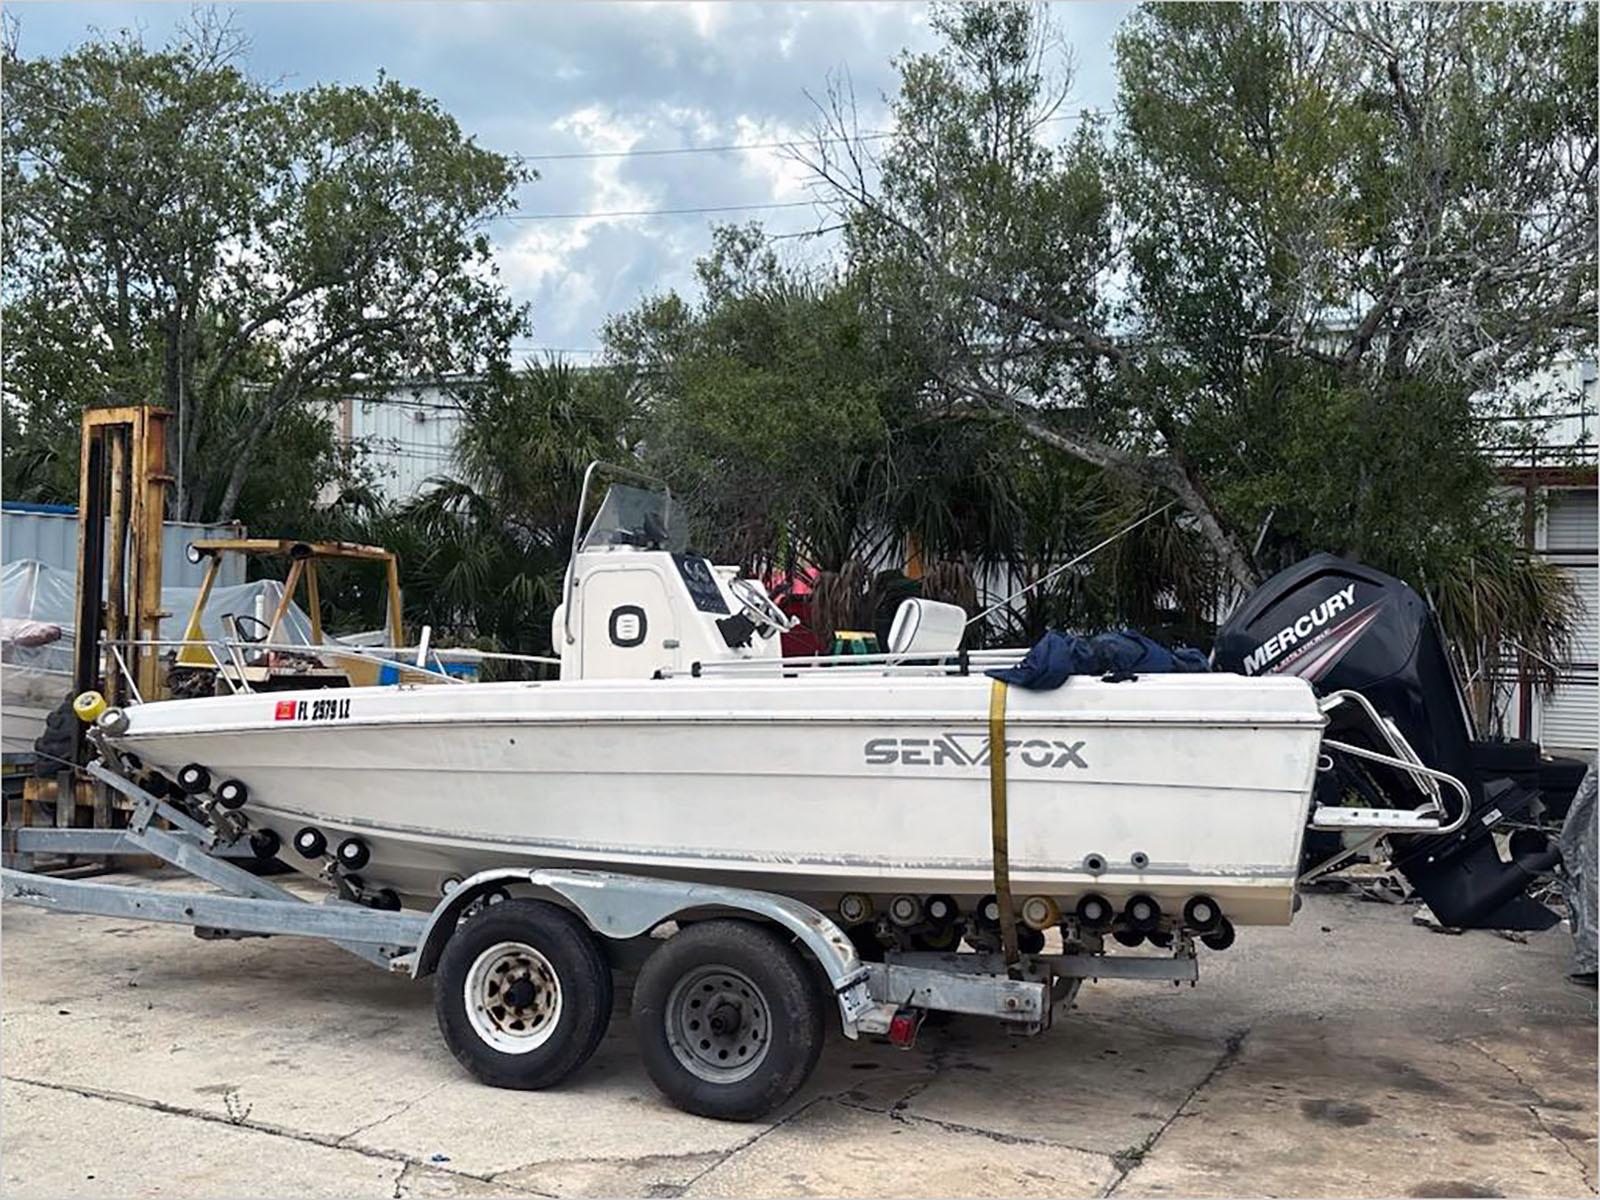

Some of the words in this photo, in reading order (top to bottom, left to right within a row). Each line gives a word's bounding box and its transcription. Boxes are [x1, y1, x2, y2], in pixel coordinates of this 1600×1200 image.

[1243, 584, 1355, 676] MERCURY
[298, 701, 308, 720] FL
[864, 739, 967, 766] SEA
